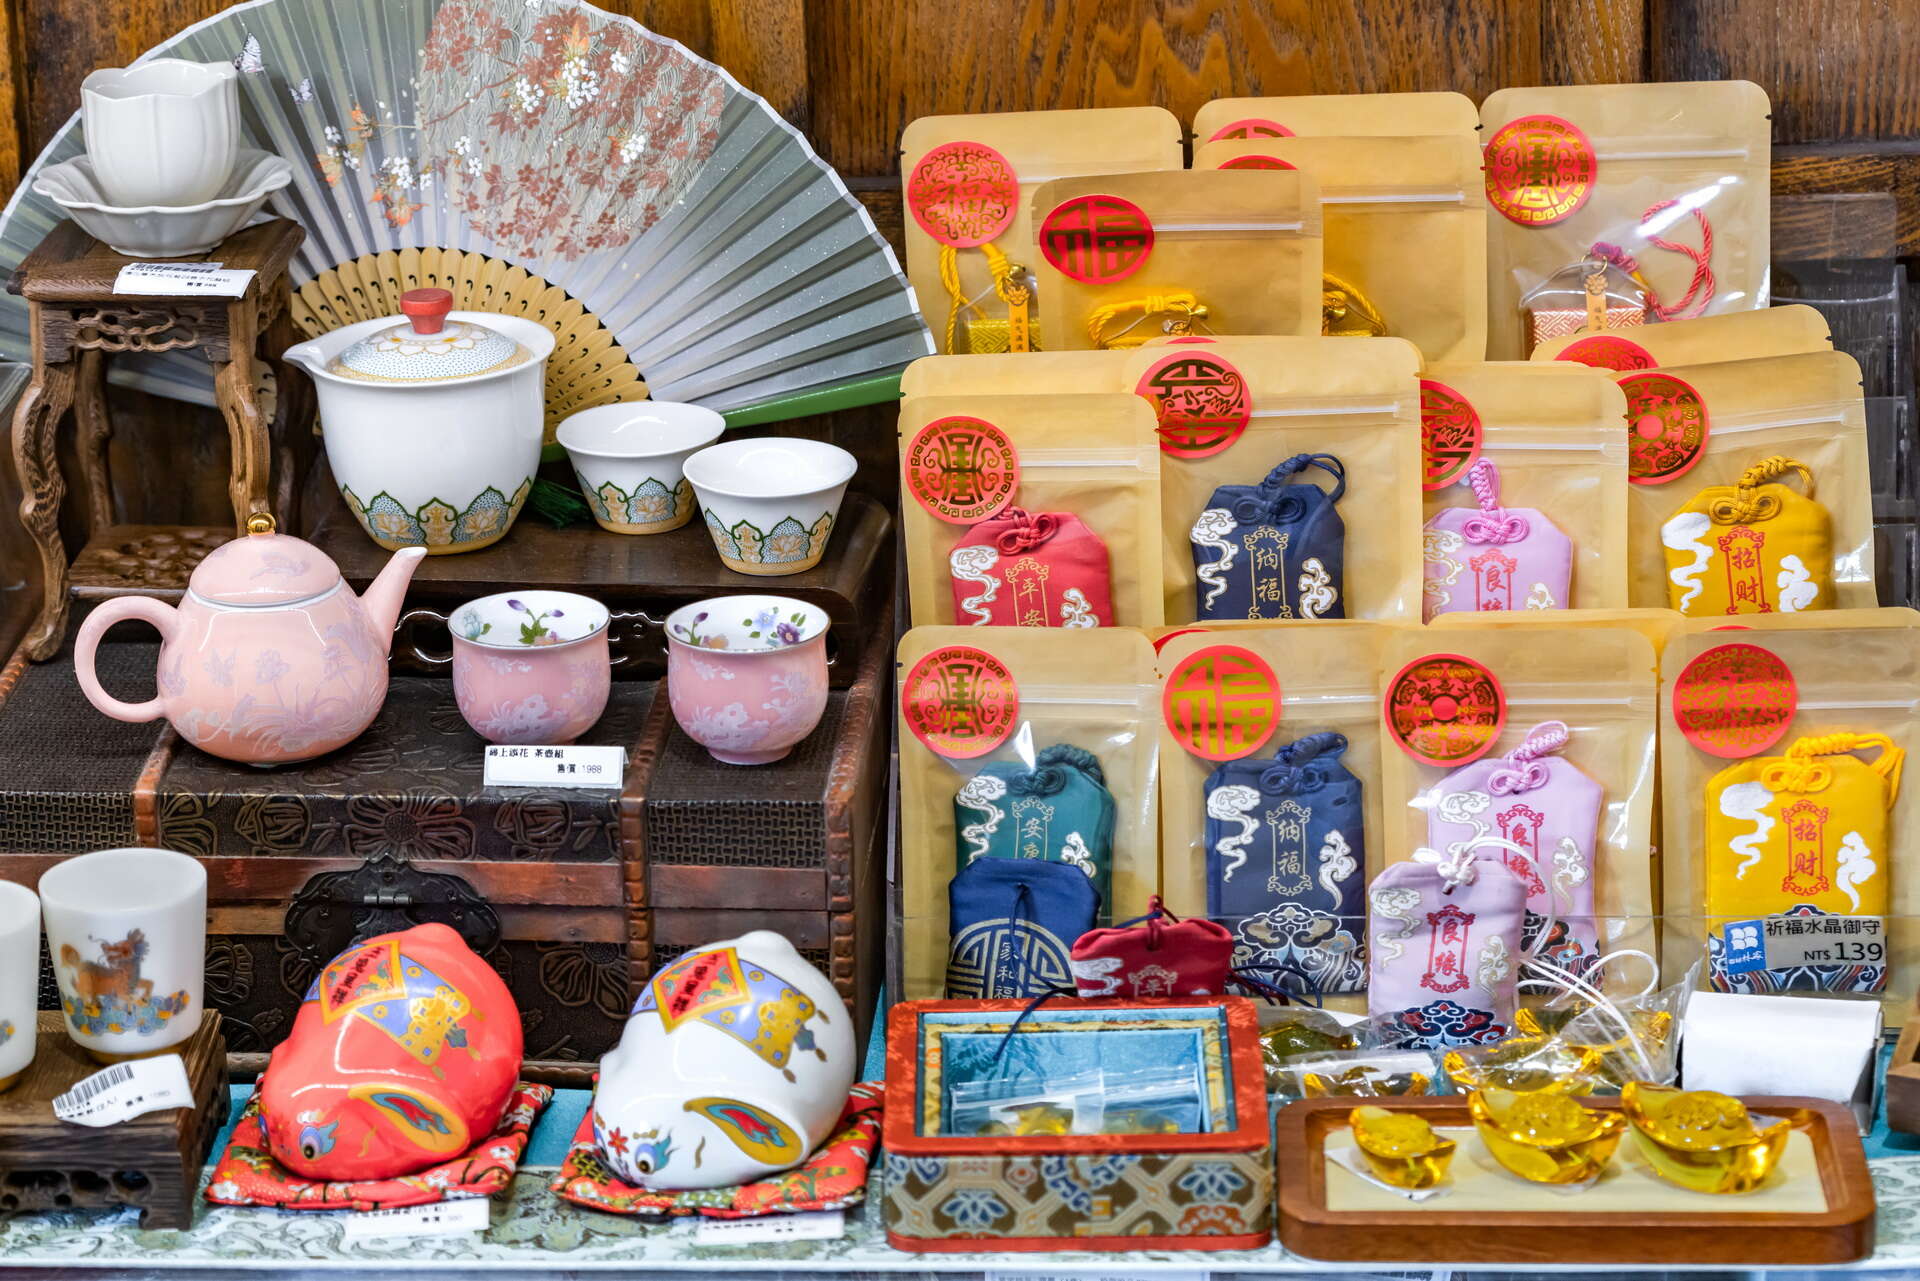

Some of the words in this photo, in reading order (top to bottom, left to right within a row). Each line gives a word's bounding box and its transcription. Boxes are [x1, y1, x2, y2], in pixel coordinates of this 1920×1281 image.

[1018, 577, 1045, 627] 平安
[582, 764, 602, 774] 1988
[1765, 919, 1881, 937] 祈福水晶御守
[1803, 950, 1831, 961] NT$
[1834, 942, 1884, 962] 139
